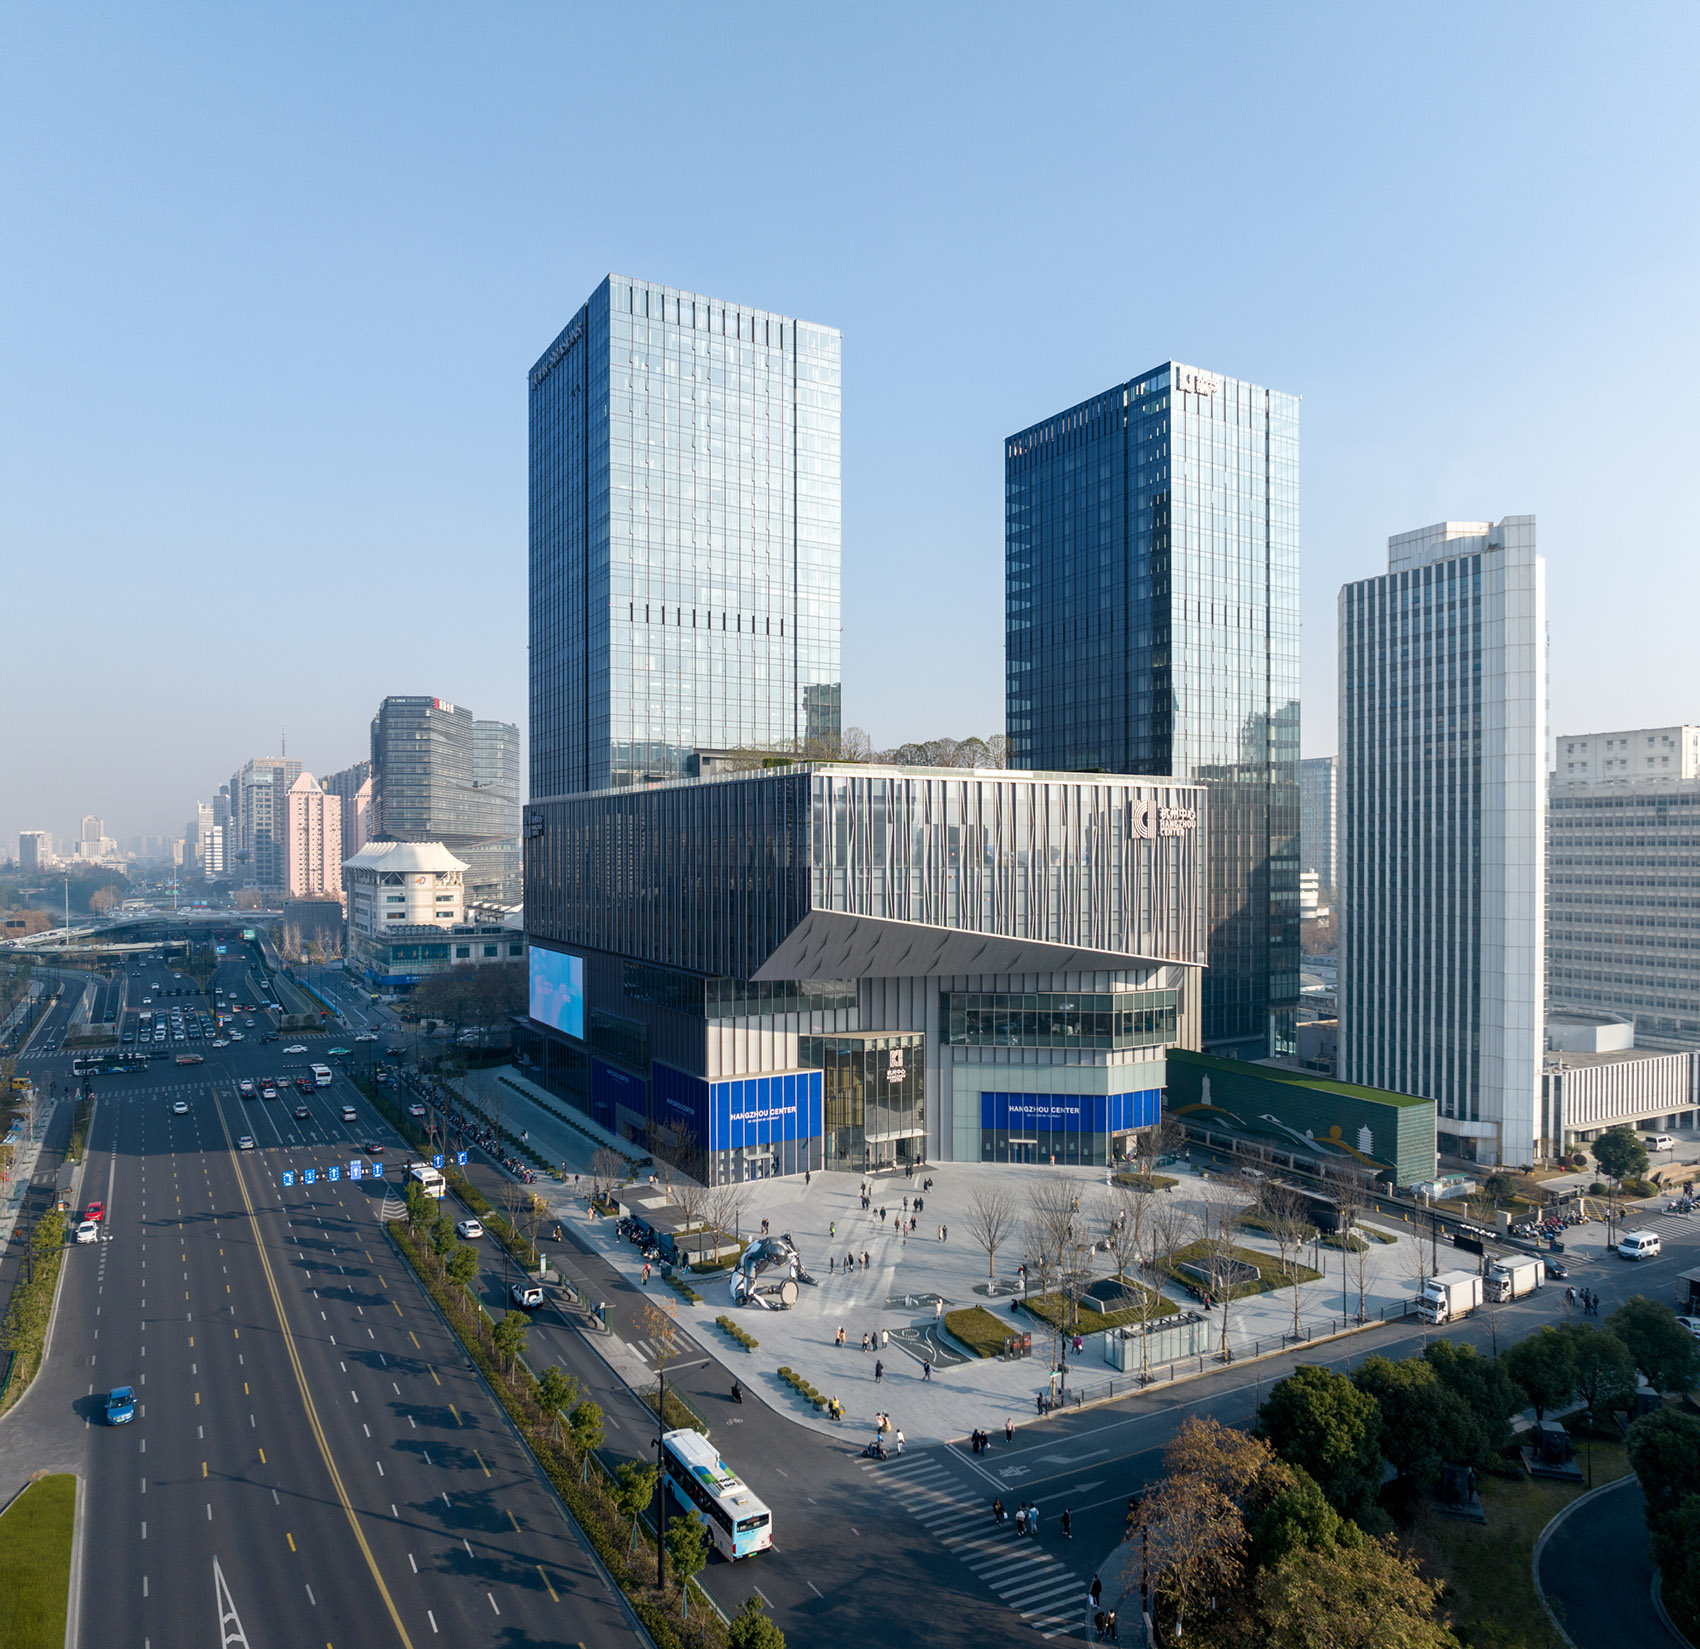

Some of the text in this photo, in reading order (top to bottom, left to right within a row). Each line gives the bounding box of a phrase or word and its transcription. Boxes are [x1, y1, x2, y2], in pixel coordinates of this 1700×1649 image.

[1159, 807, 1196, 819] 杭州中心
[1160, 820, 1196, 828] HANGZHOU
[1160, 828, 1185, 836] CENTER
[730, 1109, 769, 1121] HANGZHOU
[770, 1105, 797, 1116] CENTER
[1008, 1105, 1080, 1114] HANGZHOU CENTER
